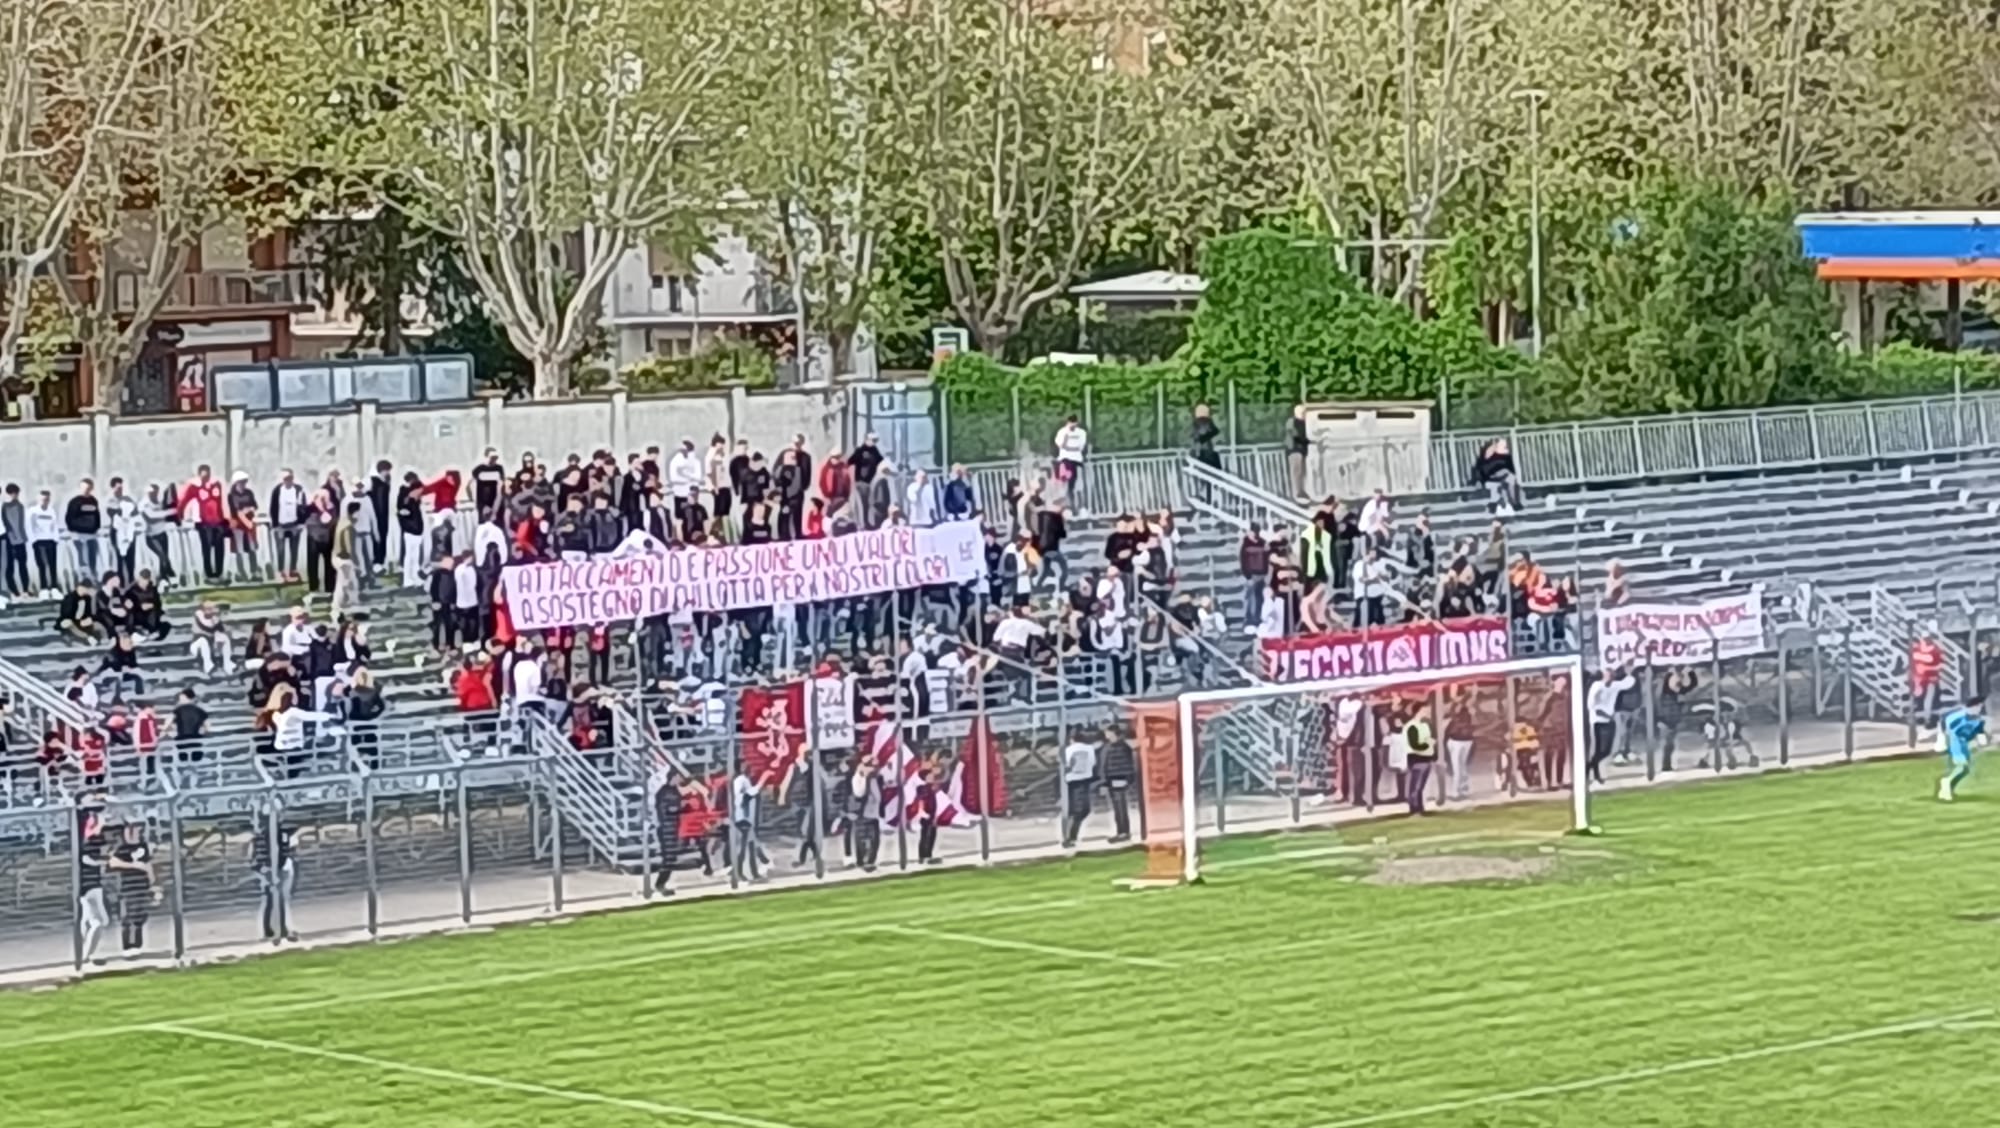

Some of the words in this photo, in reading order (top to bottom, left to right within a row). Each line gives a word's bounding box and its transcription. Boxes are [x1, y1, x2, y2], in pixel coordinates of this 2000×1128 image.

[518, 552, 681, 594] ATTACCAMENTO
[687, 552, 699, 582] E
[704, 543, 795, 579] PASSIONE
[855, 527, 916, 562] VALORI
[522, 598, 534, 624] A
[538, 588, 642, 624] SOSTEGNO
[706, 577, 766, 610] LOTTA
[771, 573, 805, 602] PER
[823, 563, 889, 595] NOSTRI
